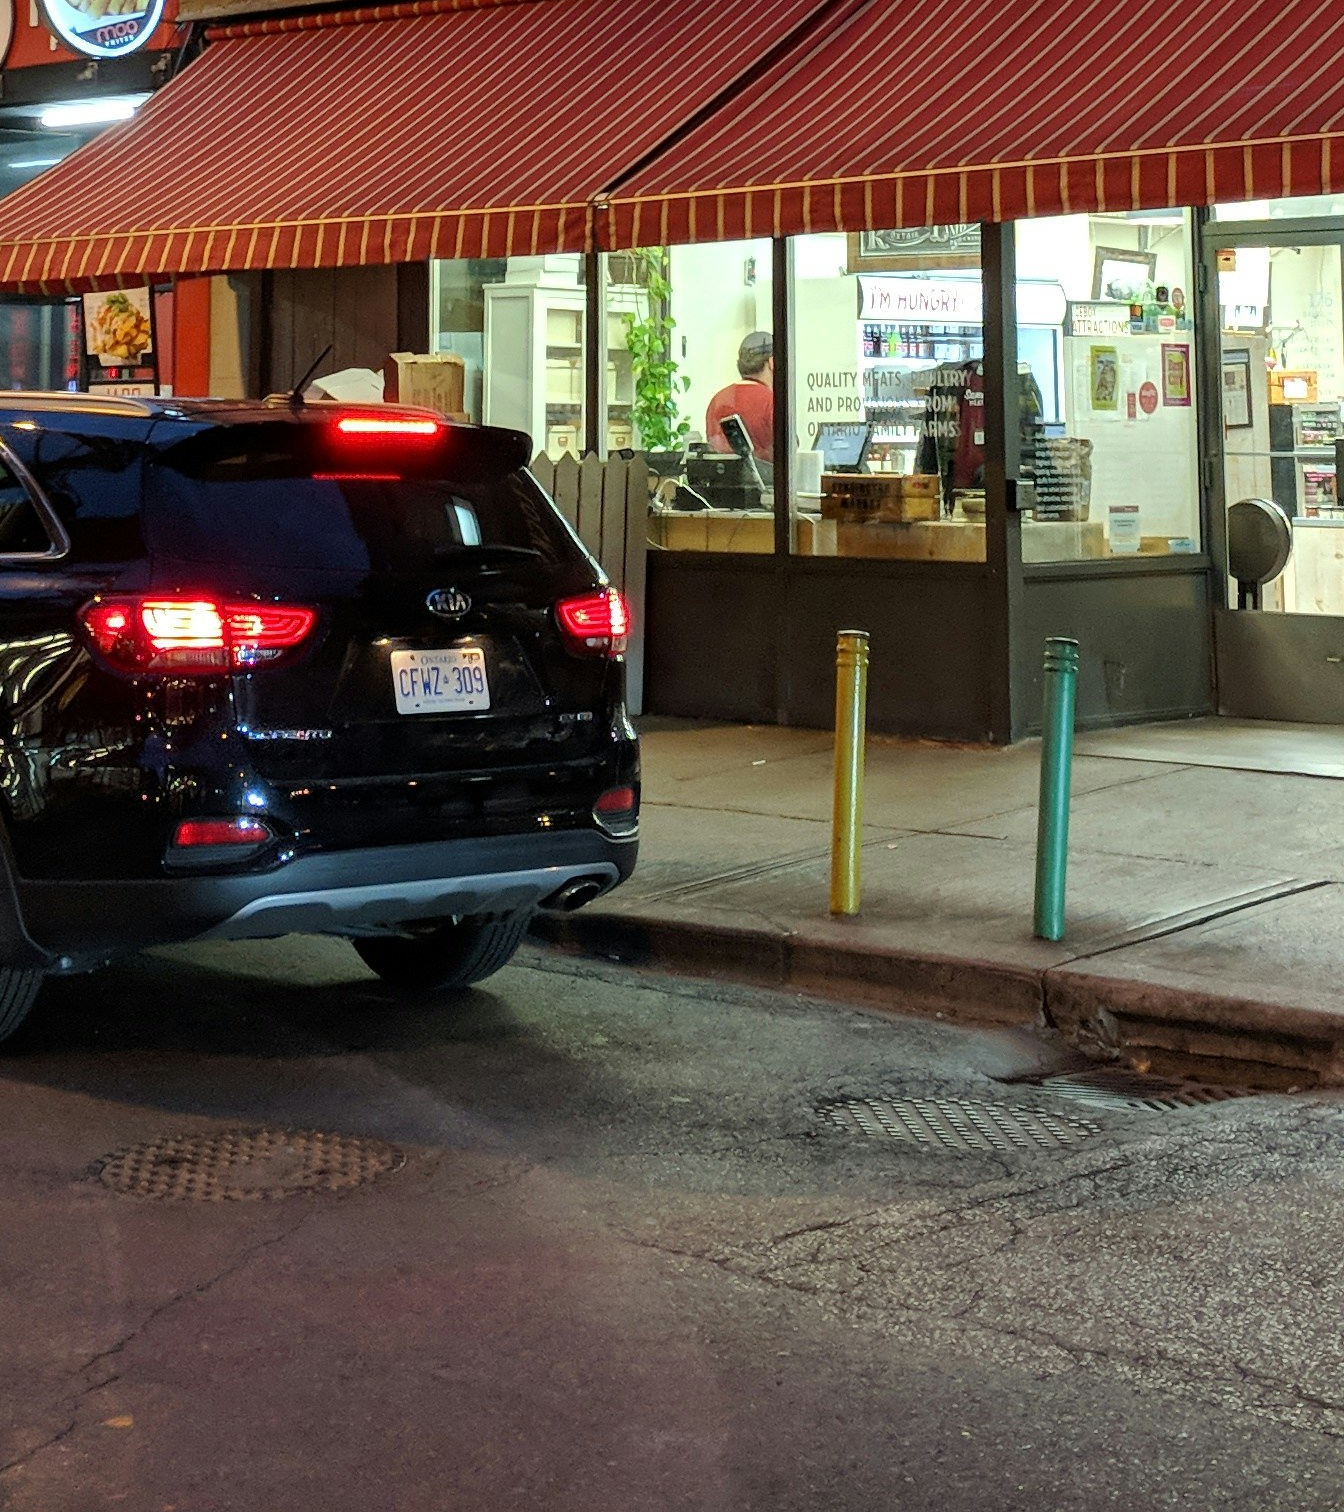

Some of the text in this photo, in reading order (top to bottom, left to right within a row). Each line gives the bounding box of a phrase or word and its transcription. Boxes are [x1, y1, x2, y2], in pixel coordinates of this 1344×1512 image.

[807, 372, 858, 391] QUALITY
[807, 396, 833, 413] AND
[434, 593, 467, 612] KIA
[420, 654, 457, 666] ONTARIO
[399, 665, 485, 698] CFWZ 309
